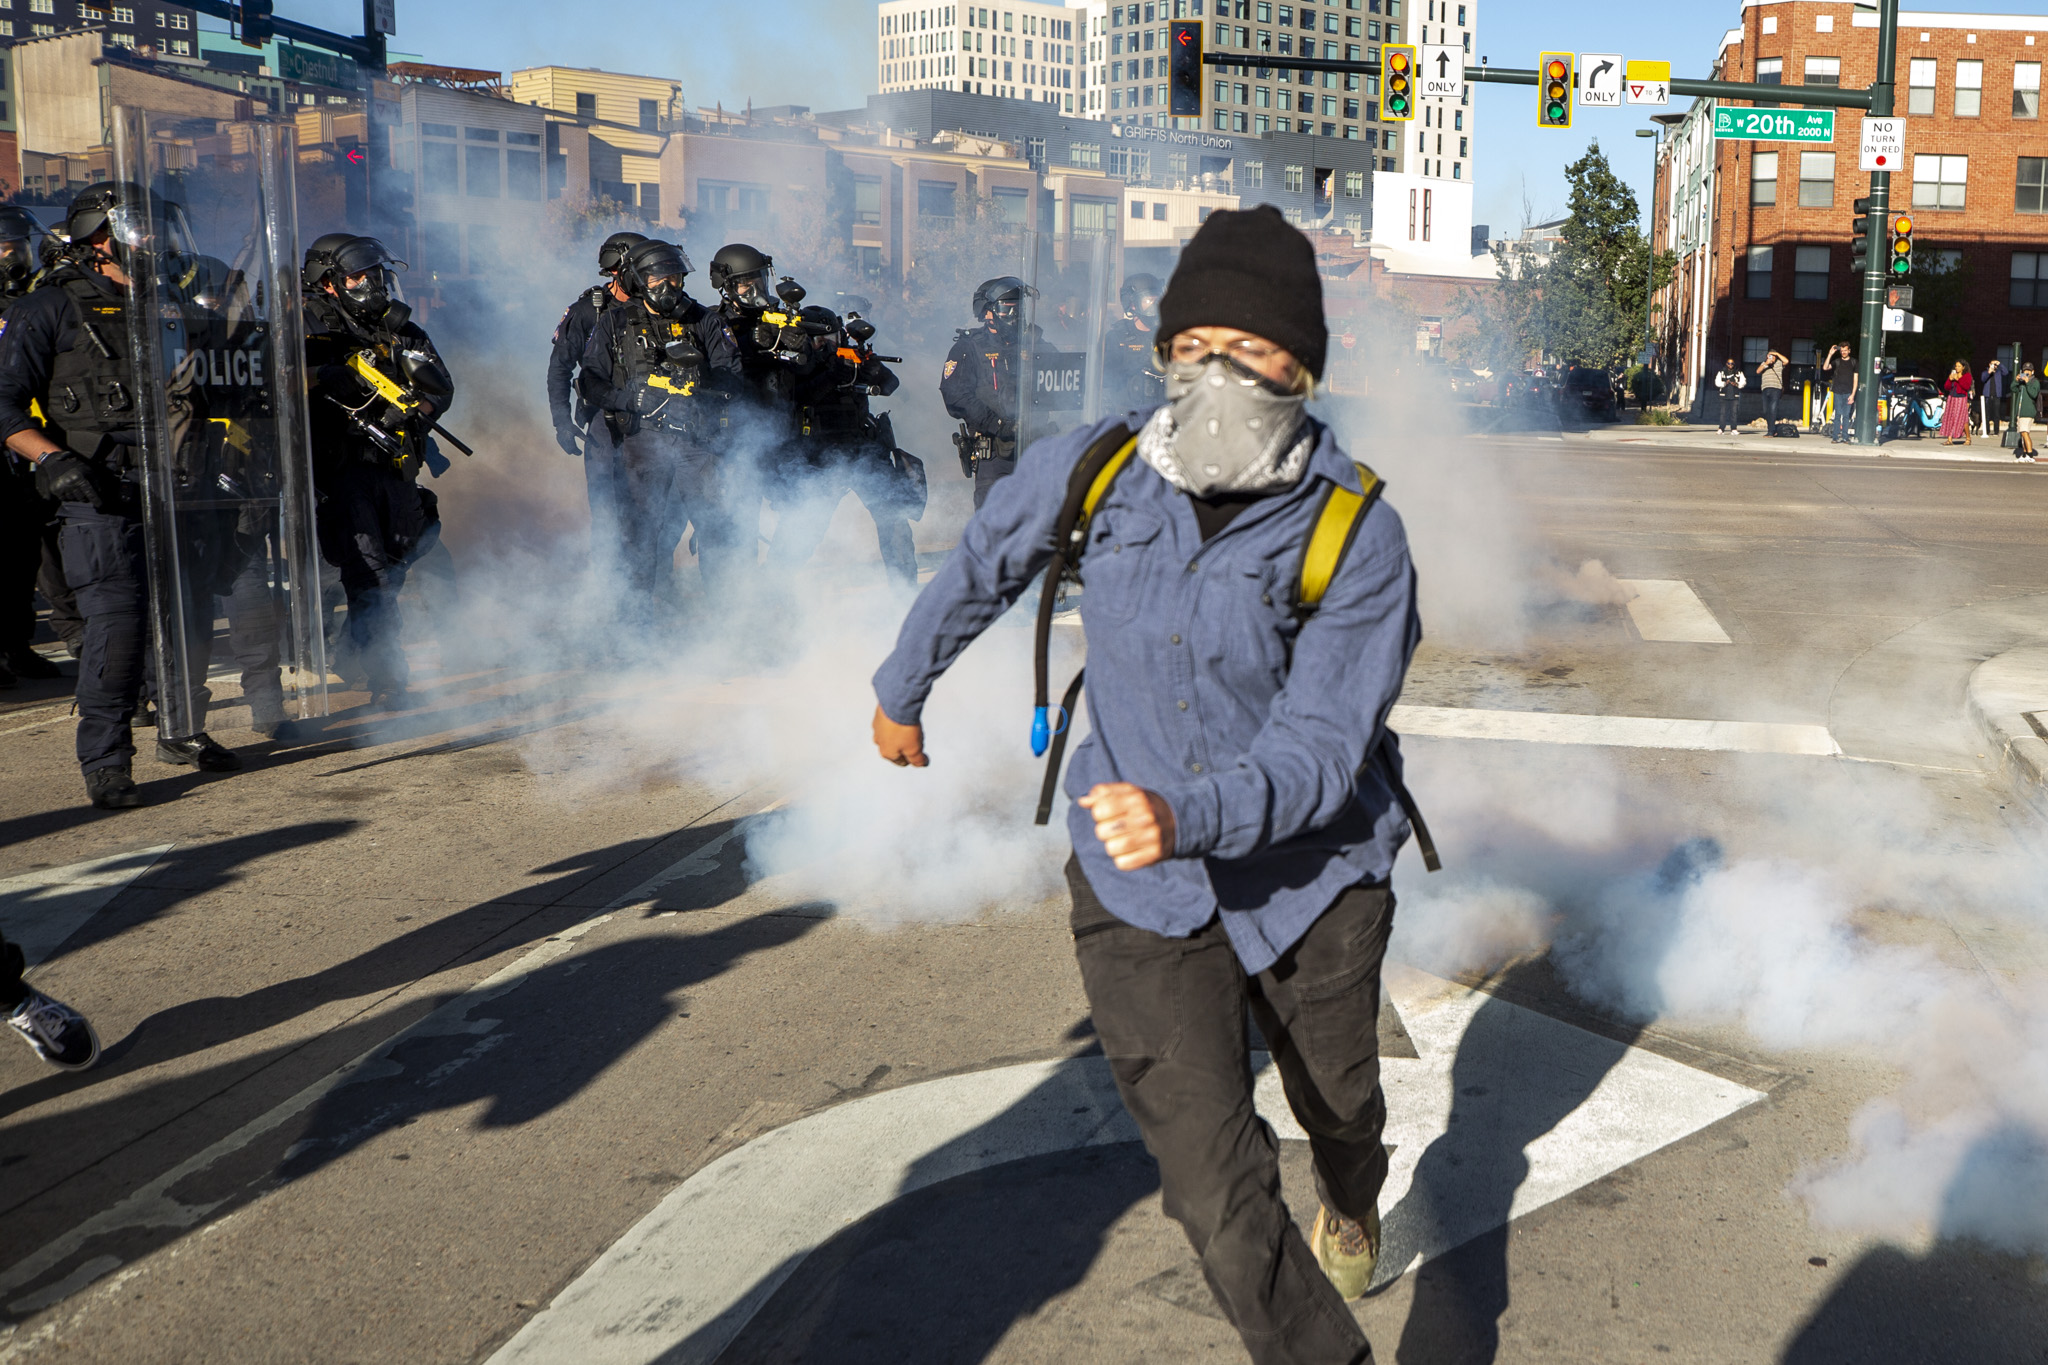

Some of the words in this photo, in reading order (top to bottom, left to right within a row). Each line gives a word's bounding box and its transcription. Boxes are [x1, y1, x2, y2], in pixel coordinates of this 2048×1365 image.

[294, 53, 338, 81] Chestnut
[1427, 81, 1457, 93] ONLY
[1585, 91, 1616, 103] ONLY
[1736, 119, 1745, 128] W
[1746, 114, 1795, 135] 20th
[1806, 115, 1823, 125] Ave
[1797, 127, 1822, 138] 2000
[1823, 128, 1831, 138] N
[1873, 122, 1893, 133] NO
[1124, 125, 1167, 142] GRIFFIS
[1169, 132, 1198, 145] North
[1201, 134, 1232, 150] Union
[1870, 134, 1896, 143] TURN
[1863, 145, 1877, 153] ON
[1881, 145, 1901, 154] RED
[1894, 315, 1902, 324] P
[173, 348, 263, 386] POLICE
[1036, 369, 1081, 392] POLICE
